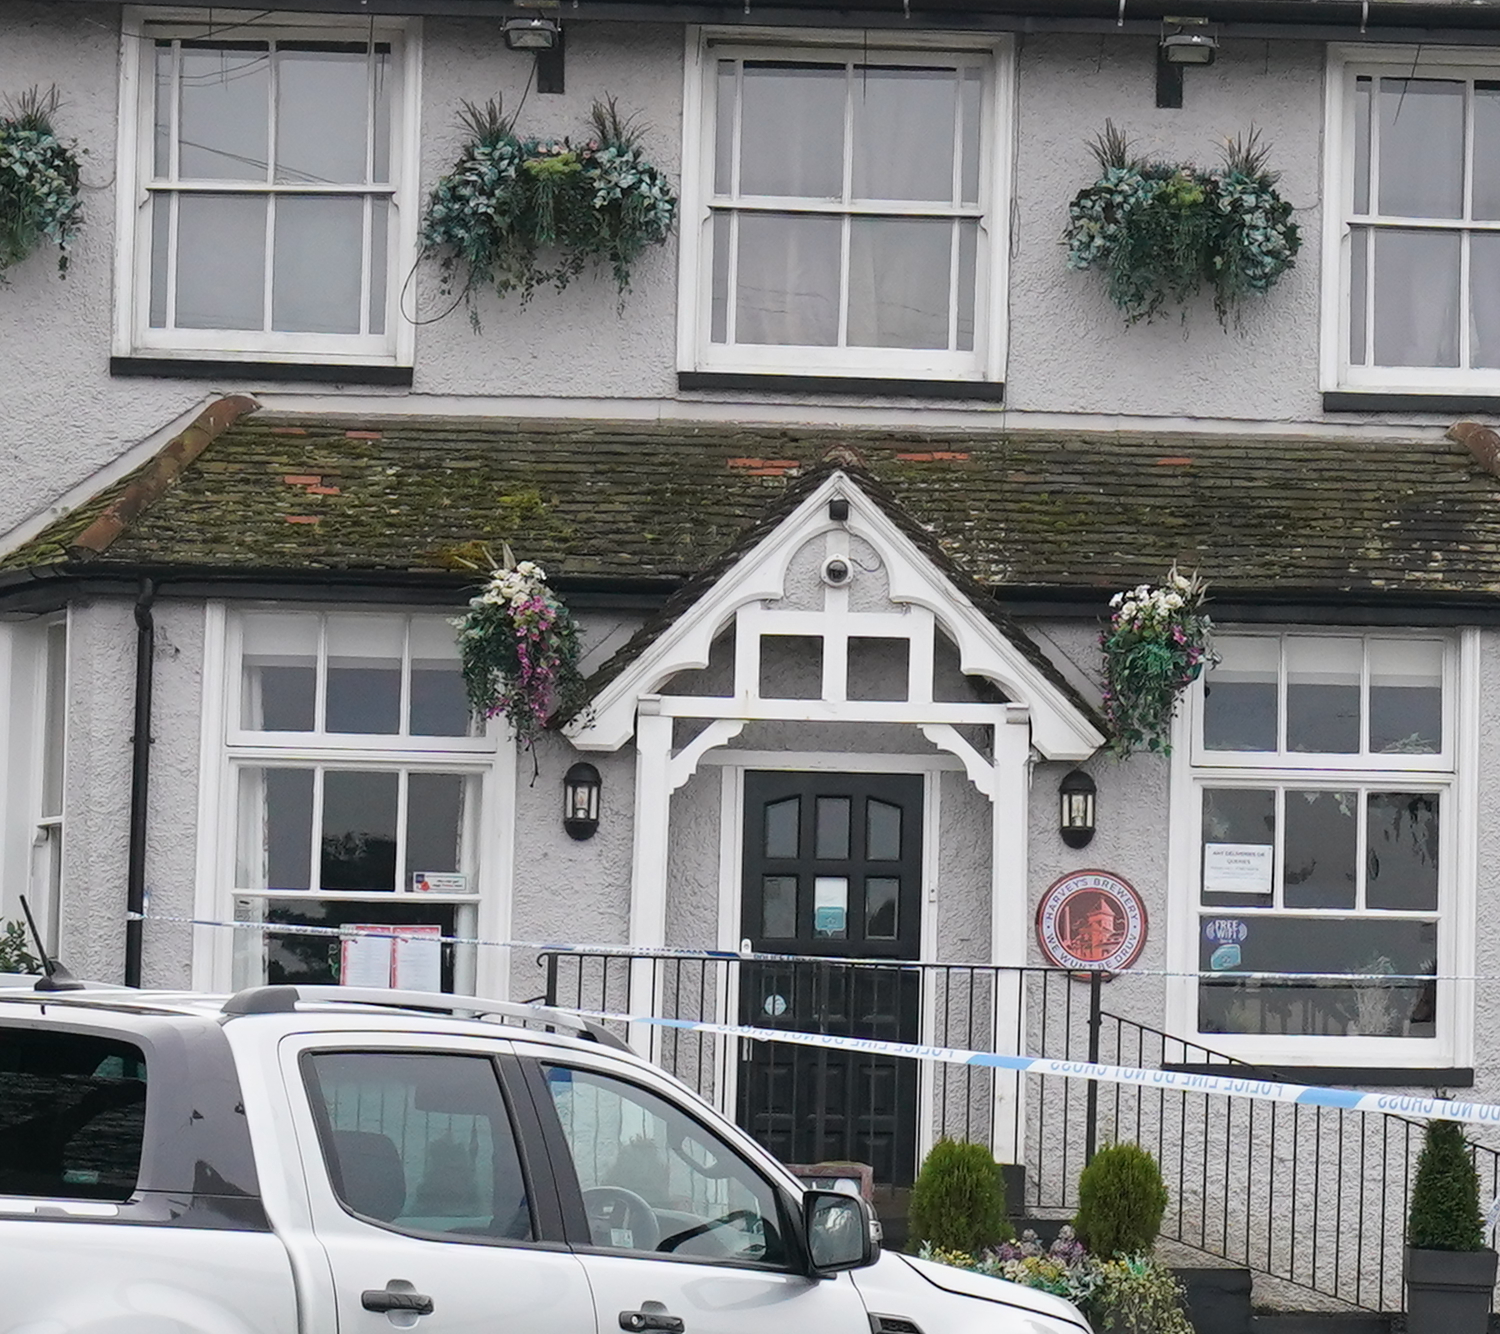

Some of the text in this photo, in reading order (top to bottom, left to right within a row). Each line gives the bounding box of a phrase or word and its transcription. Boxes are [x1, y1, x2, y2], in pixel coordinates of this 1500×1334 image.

[1093, 877, 1139, 921] BREWERY
[1215, 919, 1239, 930] FREE
[1046, 933, 1059, 953] WE
[1114, 933, 1137, 964] DRUV
